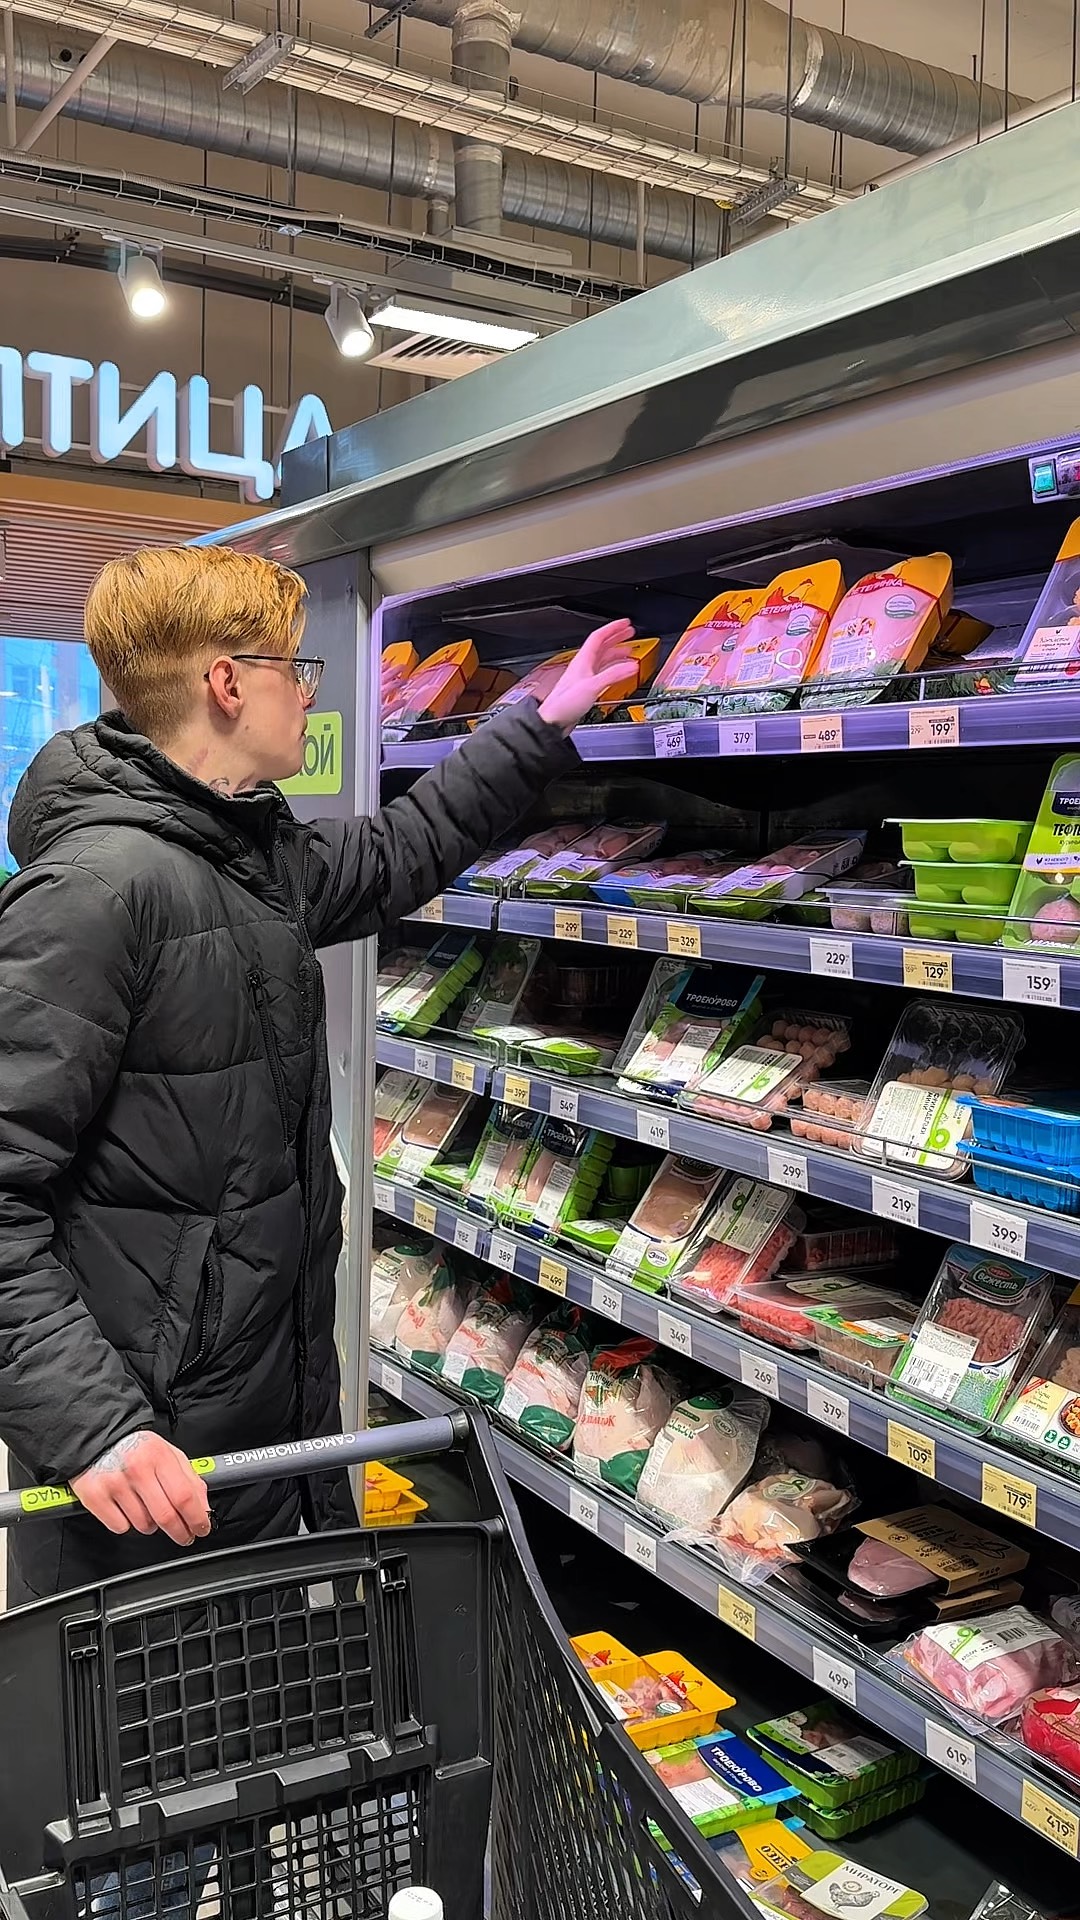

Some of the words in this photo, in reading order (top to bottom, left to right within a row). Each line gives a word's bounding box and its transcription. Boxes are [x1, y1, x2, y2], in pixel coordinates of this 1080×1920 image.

[818, 730, 836, 741] 489
[930, 724, 950, 736] 199
[666, 737, 682, 748] 469
[734, 732, 750, 744] 379
[565, 922, 578, 932] 299
[618, 928, 632, 939] 229
[680, 937, 696, 947] 329
[826, 952, 846, 965] 229
[924, 967, 944, 979] 129
[1026, 976, 1051, 990] 159
[514, 1088, 527, 1099] 399
[559, 1100, 574, 1112] 549
[650, 1126, 664, 1138] 419
[782, 1164, 801, 1178] 299
[891, 1196, 912, 1212] 219
[992, 1224, 1017, 1243] 399
[550, 1274, 563, 1287] 499
[602, 1295, 617, 1308] 239
[670, 1328, 686, 1343] 349
[754, 1368, 773, 1384] 269
[822, 1401, 842, 1418] 379
[304, 1434, 356, 1453] САМОЕ
[224, 1442, 303, 1466] ЛЮБИМОЕ
[908, 1446, 928, 1464] 109
[26, 1488, 60, 1506] ЧАС
[1006, 1491, 1028, 1510] 179
[580, 1504, 594, 1519] 929
[636, 1542, 652, 1558] 269
[732, 1608, 750, 1624] 499
[828, 1670, 850, 1690] 499
[946, 1746, 970, 1766] 619
[1046, 1815, 1070, 1836] 419
[842, 1864, 902, 1894] МИРАТОРГ
